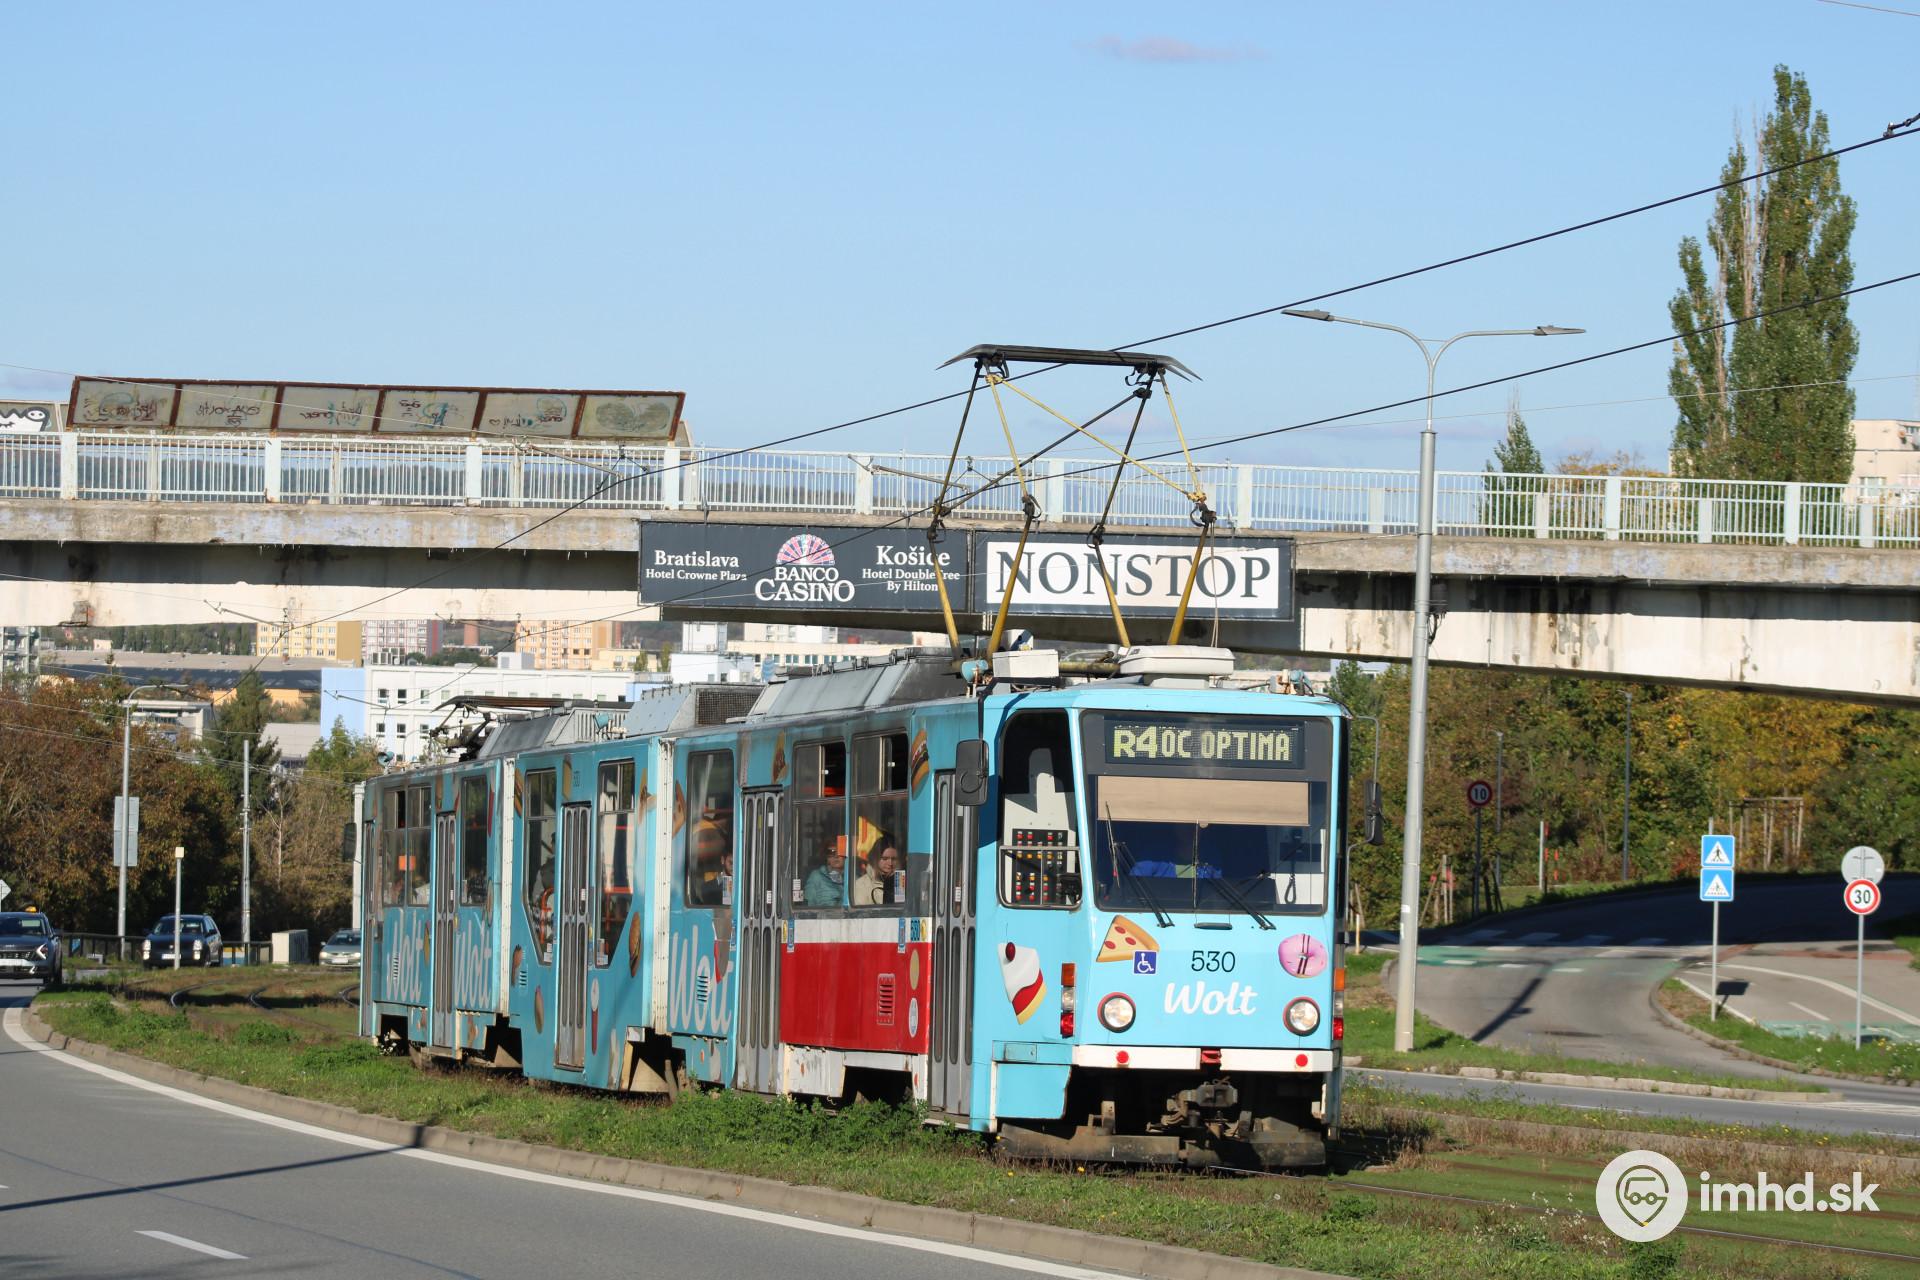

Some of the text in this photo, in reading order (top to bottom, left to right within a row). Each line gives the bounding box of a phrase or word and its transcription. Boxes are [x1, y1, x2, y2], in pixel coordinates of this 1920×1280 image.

[654, 550, 739, 568] Bratislava
[876, 545, 951, 566] Košice
[646, 568, 747, 581] Hotel Crowne Plaza
[774, 566, 839, 582] BANCO
[862, 568, 961, 580] Hotel Doubleree
[995, 551, 1271, 598] NONSTOP
[754, 578, 855, 602] CASINO
[887, 580, 938, 593] By Hilton
[1201, 730, 1291, 761] OPTIMA
[1474, 788, 1487, 800] 10
[1854, 889, 1871, 904] 30
[386, 908, 423, 1003] Wolt
[454, 918, 493, 1009] Wolt
[1191, 950, 1236, 973] 530
[1164, 980, 1258, 1015] Wolt
